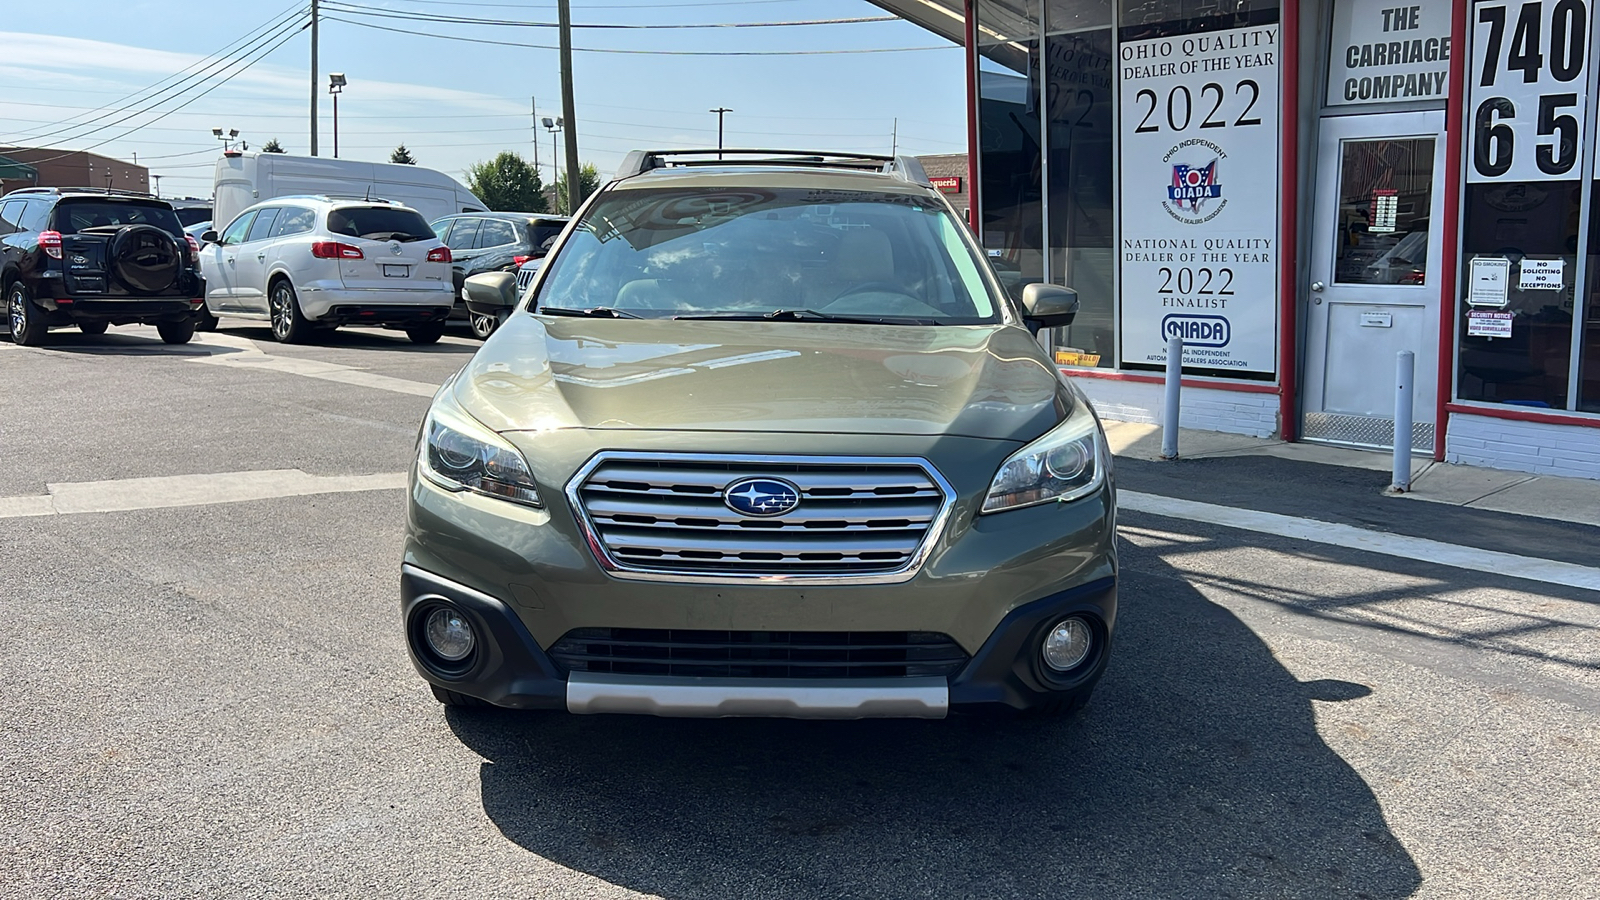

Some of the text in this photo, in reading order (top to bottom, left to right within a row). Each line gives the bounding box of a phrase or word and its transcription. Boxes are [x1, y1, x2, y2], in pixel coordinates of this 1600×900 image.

[1381, 6, 1420, 32] THE
[1122, 42, 1172, 61] OHIO
[1182, 29, 1277, 56] QUALITY
[1346, 37, 1451, 68] CARRIAGE
[1479, 0, 1586, 86] 740
[1124, 62, 1176, 80] DEALER
[1180, 60, 1198, 74] OF
[1202, 57, 1230, 72] THE
[1234, 52, 1274, 68] YEAR
[1344, 71, 1447, 101] COMPANY
[1134, 79, 1262, 133] 2022
[1162, 139, 1228, 163] OHIO INDEPENDENT
[930, 178, 956, 188] queria
[1174, 186, 1212, 198] OIADA
[1124, 238, 1272, 250] NATIONAL QUALITY
[1126, 253, 1270, 263] DEALER OF THE YEAR
[1158, 267, 1234, 295] 2022
[1163, 298, 1227, 308] FINALIST
[1167, 321, 1224, 340] NIADA
